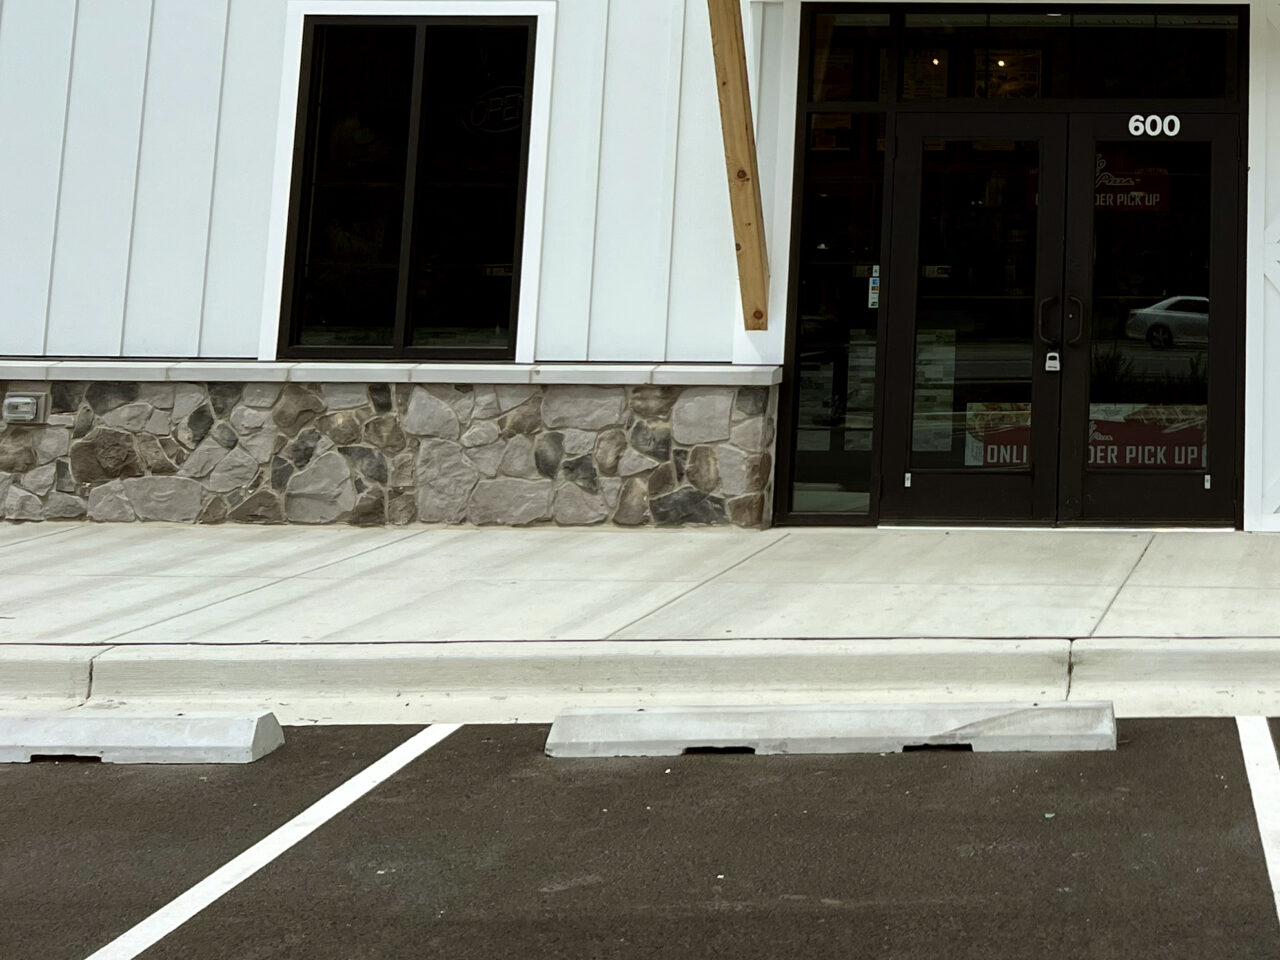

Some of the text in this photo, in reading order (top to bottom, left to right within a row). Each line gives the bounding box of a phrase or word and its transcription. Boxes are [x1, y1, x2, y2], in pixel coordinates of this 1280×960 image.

[1128, 114, 1181, 137] 600
[1116, 192, 1142, 207] PICK
[1145, 193, 1161, 207] UP
[986, 444, 1028, 464] ONLI
[1125, 445, 1168, 465] PICK
[1174, 445, 1199, 465] UP
